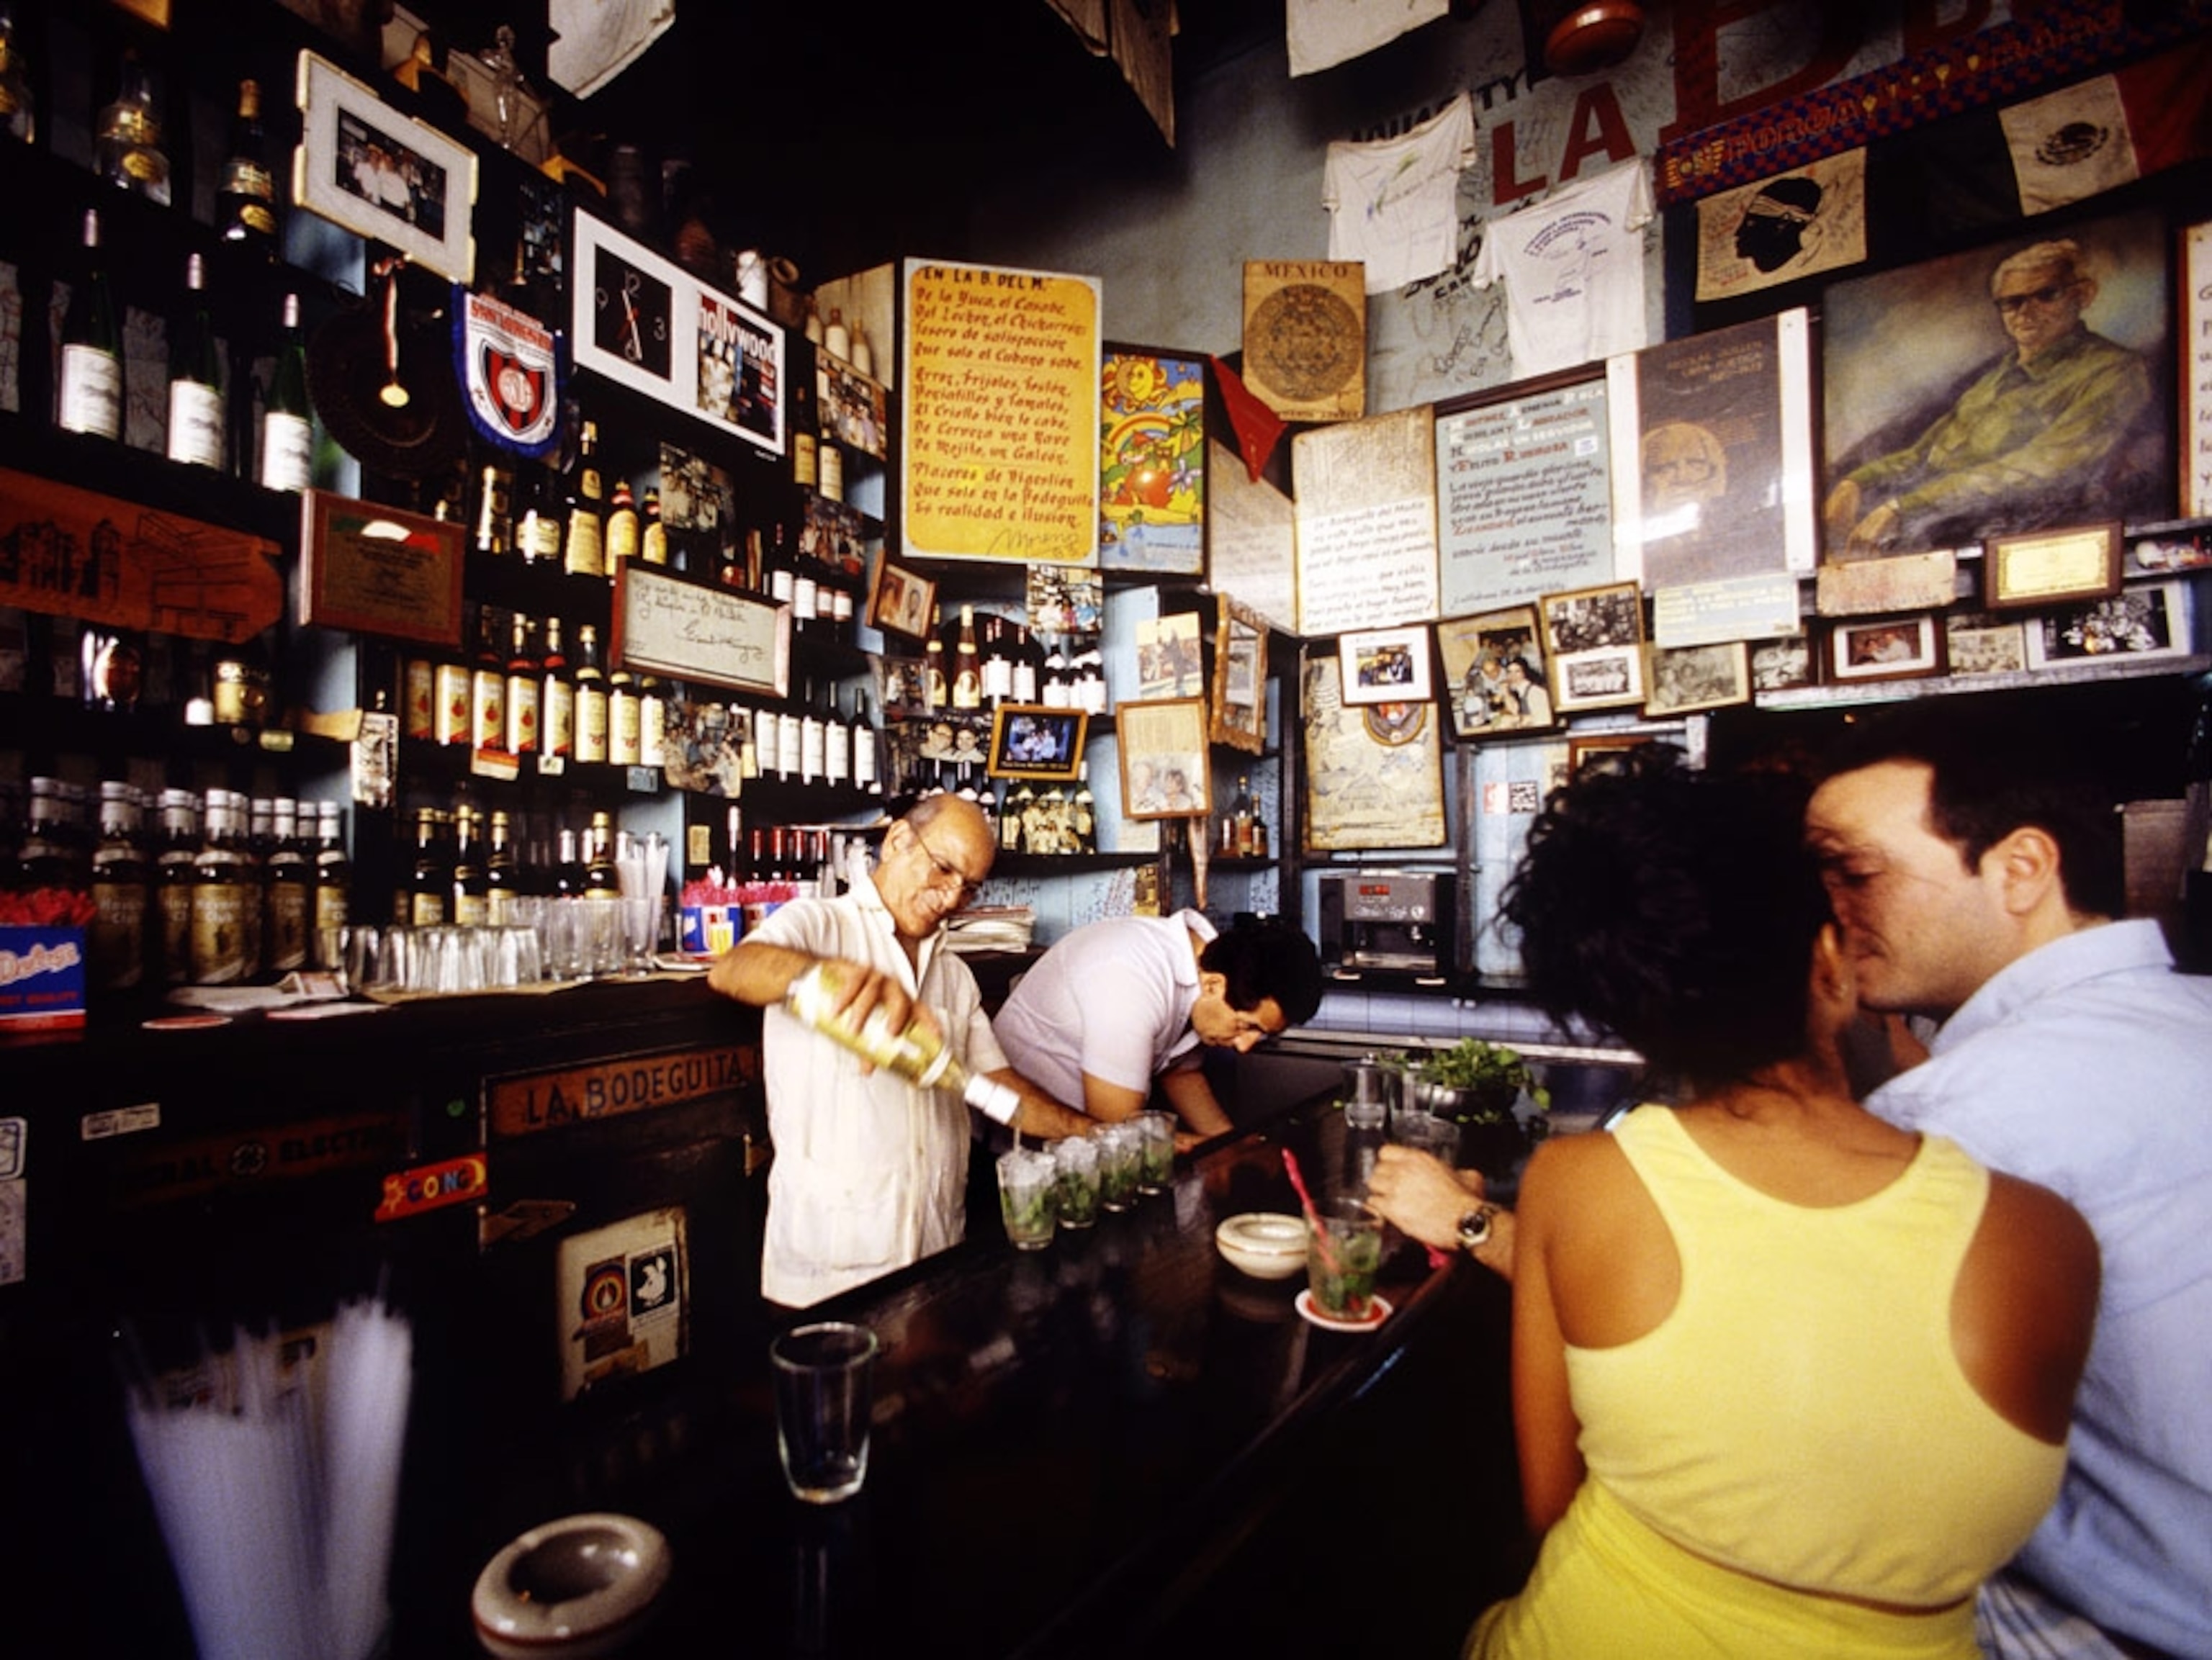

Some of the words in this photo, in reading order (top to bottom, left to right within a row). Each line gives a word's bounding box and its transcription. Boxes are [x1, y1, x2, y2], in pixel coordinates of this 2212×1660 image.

[1493, 83, 1636, 207] LA
[953, 269, 972, 283] LA
[998, 274, 1025, 289] DEL
[1265, 263, 1349, 279] MEXICO
[999, 296, 1011, 307] el
[994, 313, 1007, 325] el
[653, 316, 666, 340] 3
[963, 328, 979, 340] de
[979, 348, 992, 359] el
[985, 469, 1002, 482] de
[938, 504, 1004, 521] realidad
[526, 1083, 570, 1125] LA
[585, 1051, 744, 1114] BODEGUITA
